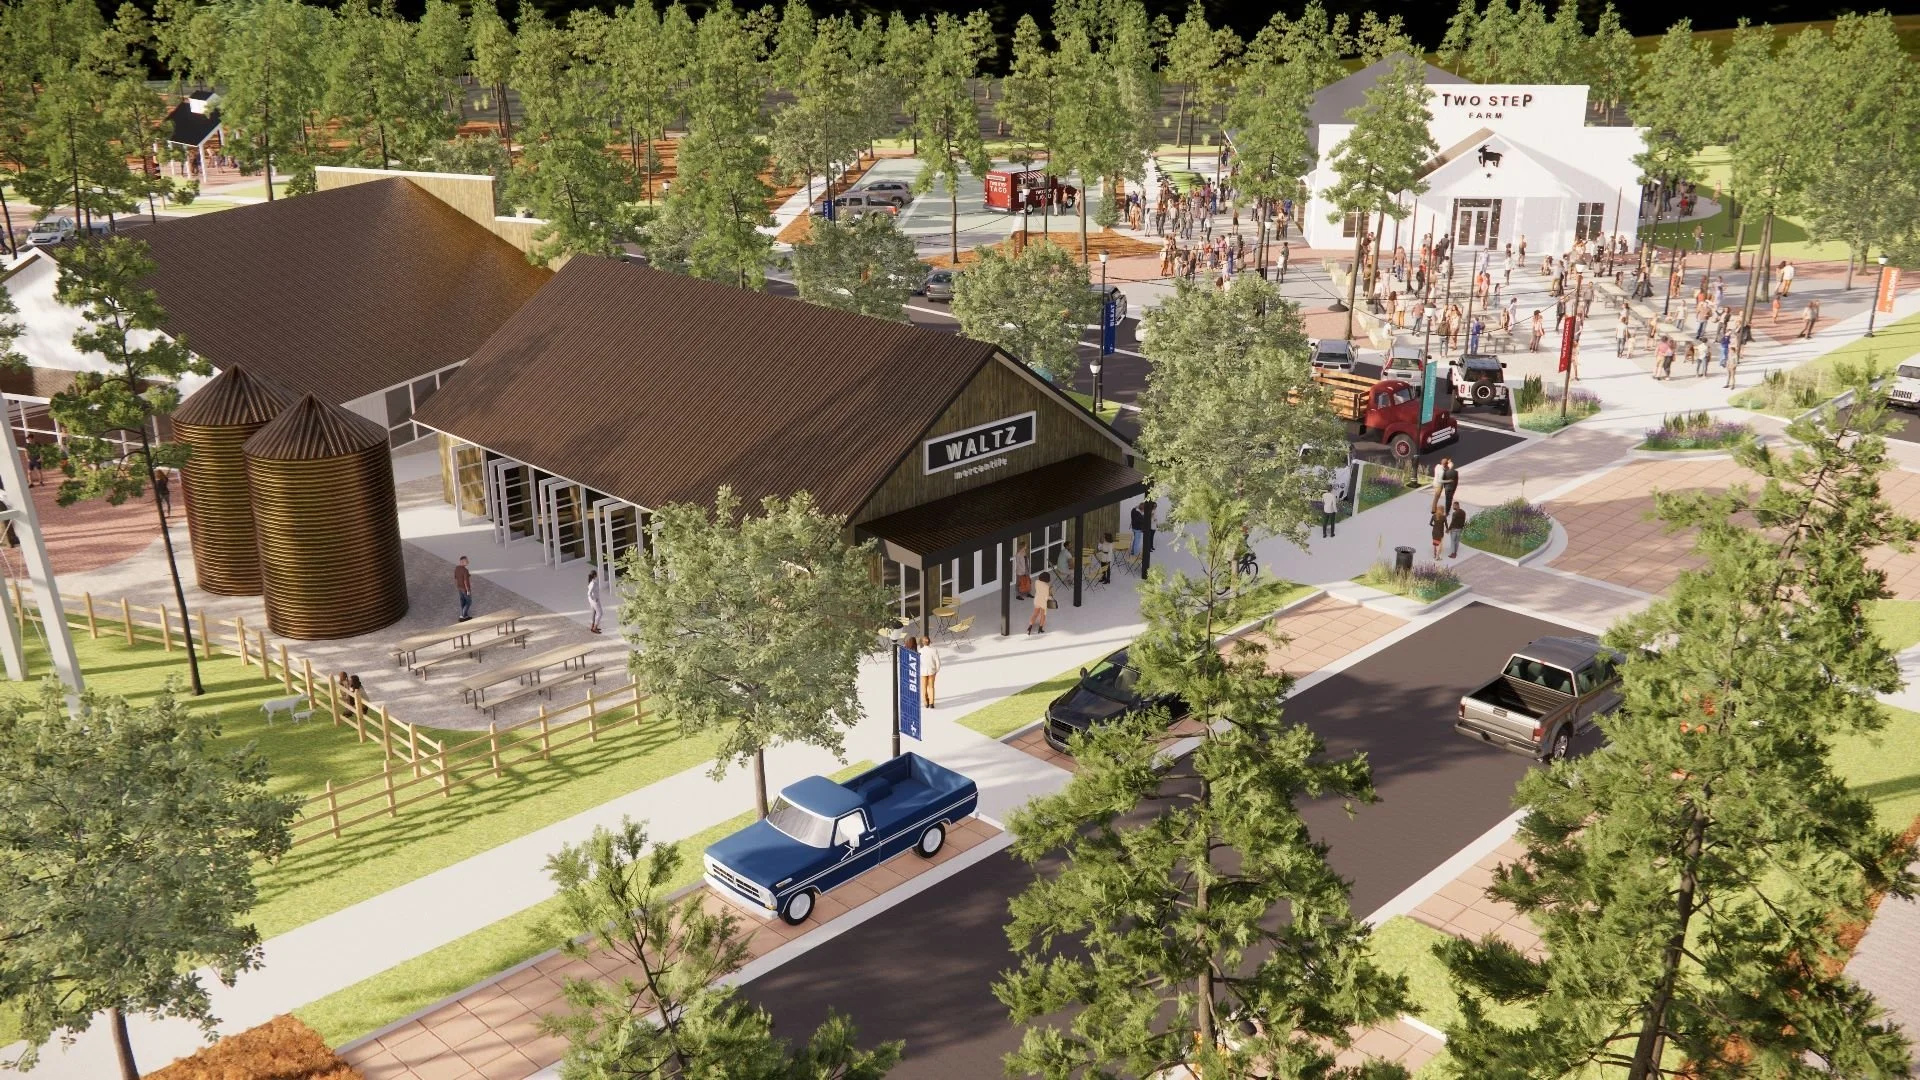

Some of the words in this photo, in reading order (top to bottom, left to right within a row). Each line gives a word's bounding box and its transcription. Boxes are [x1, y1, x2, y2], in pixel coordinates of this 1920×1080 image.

[1442, 93, 1481, 106] TWO
[1488, 94, 1533, 107] STEP
[989, 185, 1008, 194] TACO
[1562, 322, 1571, 359] WELCOME
[945, 425, 1017, 462] WALTZ
[953, 457, 1008, 480] mercantile
[909, 653, 918, 693] BLEAT
